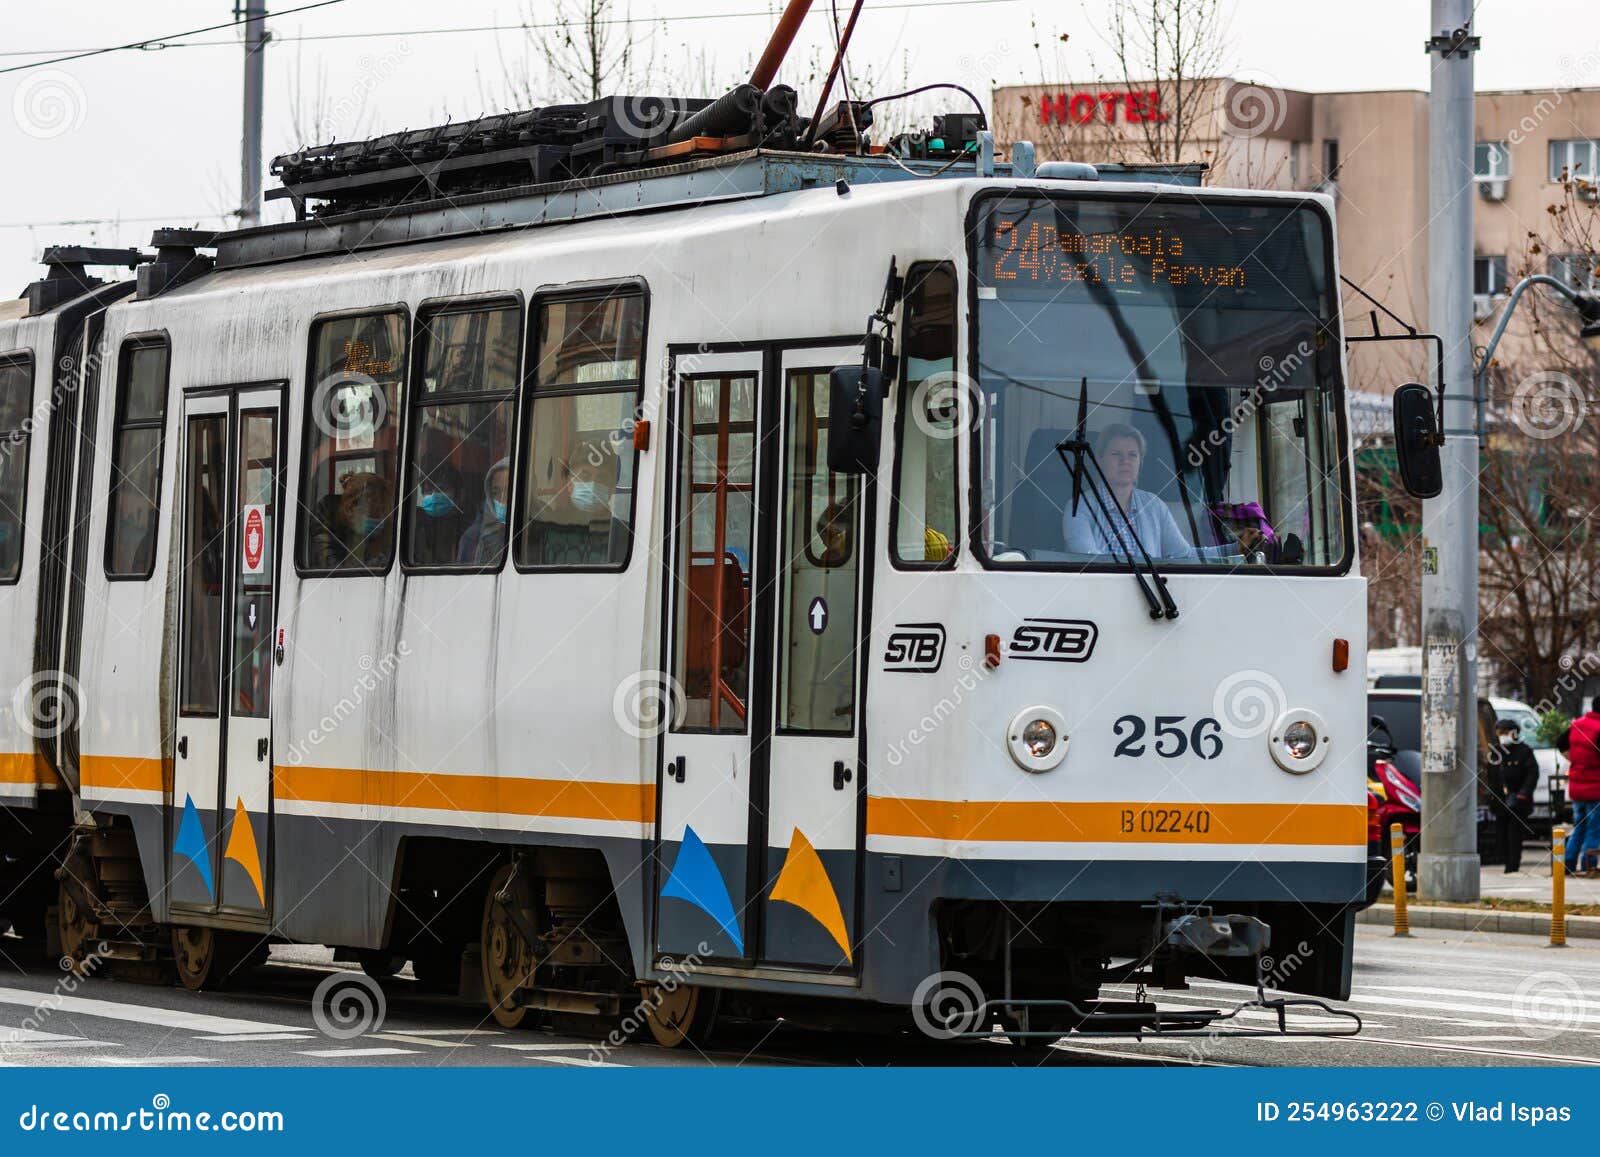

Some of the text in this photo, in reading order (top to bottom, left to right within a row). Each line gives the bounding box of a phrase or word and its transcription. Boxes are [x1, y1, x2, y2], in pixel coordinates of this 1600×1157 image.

[1040, 90, 1168, 125] HOTEL
[994, 221, 1041, 280] 24
[1042, 255, 1246, 286] Vasile Parvan
[883, 630, 942, 664] STB
[1009, 624, 1091, 655] STB
[1113, 715, 1223, 760] 256
[1121, 810, 1210, 833] B 02240
